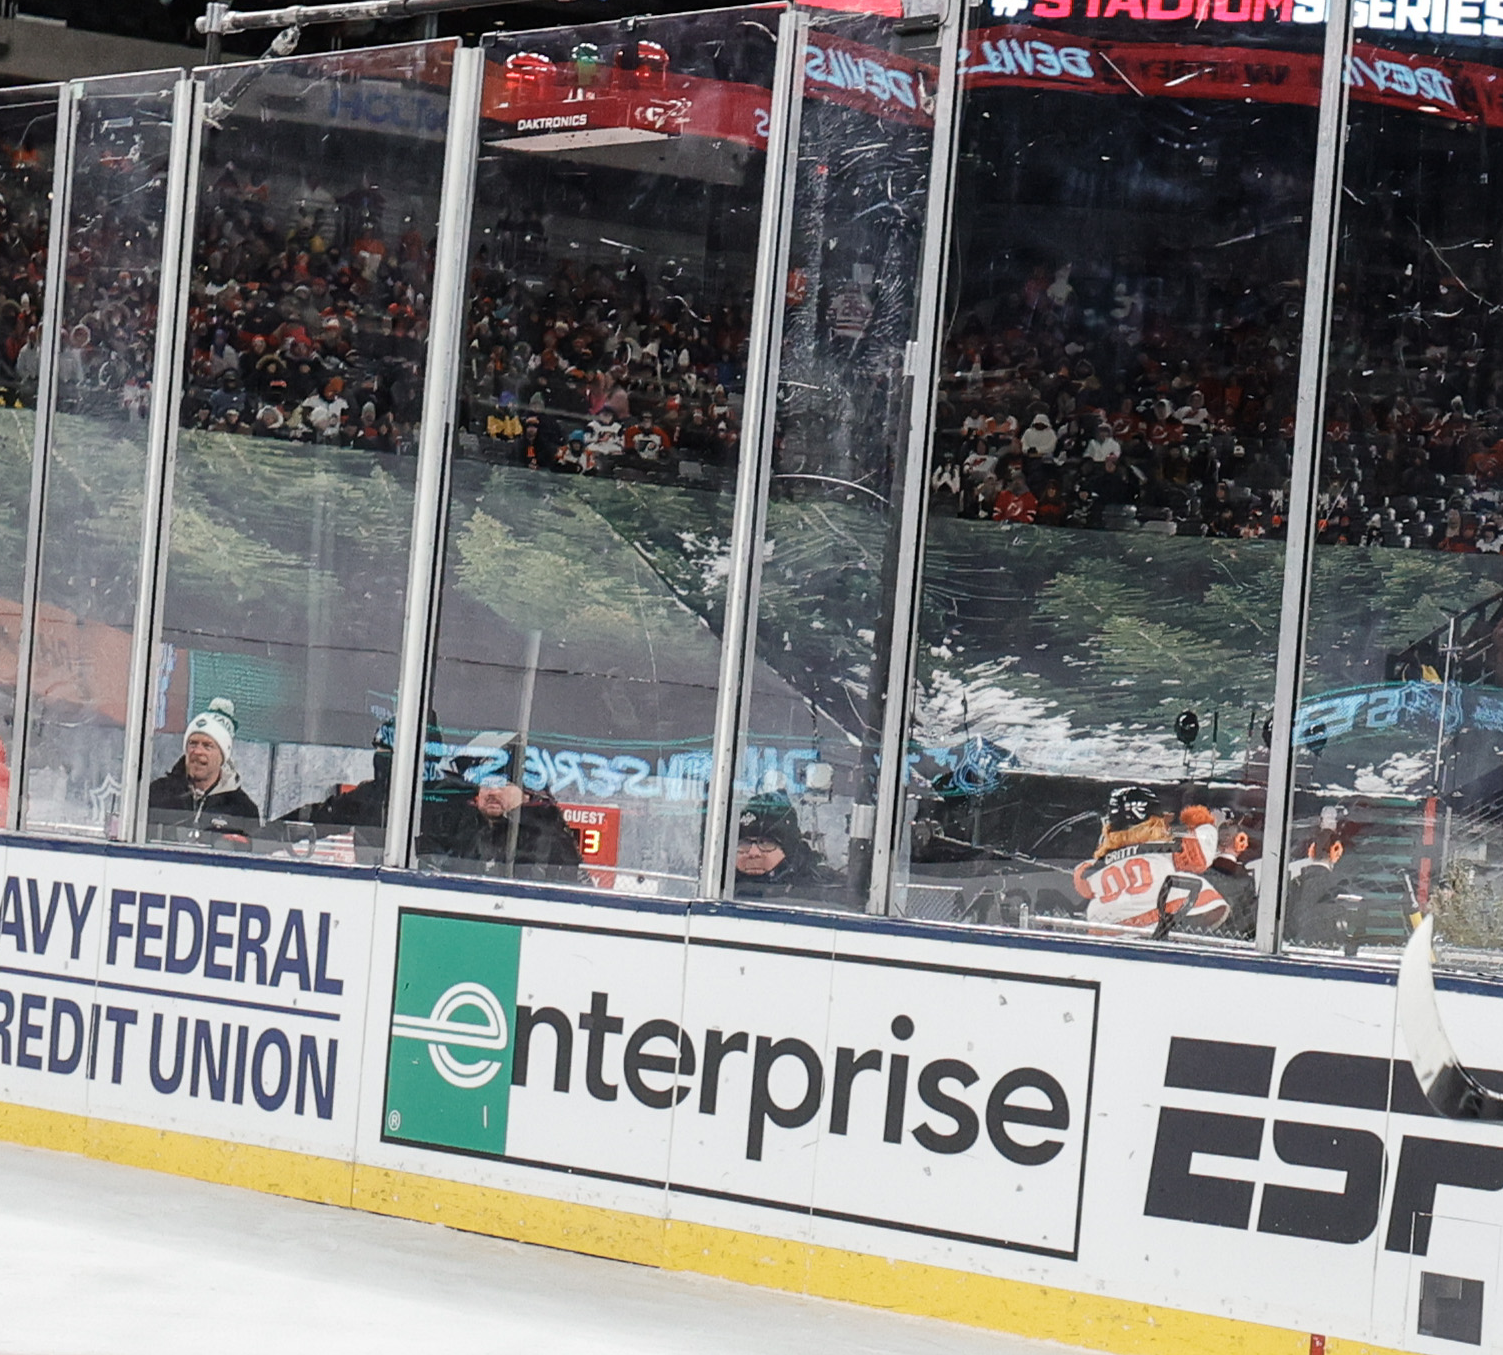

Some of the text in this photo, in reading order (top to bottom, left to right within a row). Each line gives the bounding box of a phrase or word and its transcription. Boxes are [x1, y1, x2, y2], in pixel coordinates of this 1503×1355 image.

[516, 111, 589, 132] DAKTRONICS
[563, 807, 606, 826] GUEST
[583, 830, 601, 854] 3
[1099, 857, 1154, 904] 00
[105, 888, 345, 997] FEDERAL
[148, 1012, 340, 1122] UNION
[397, 980, 1072, 1168] enterprise
